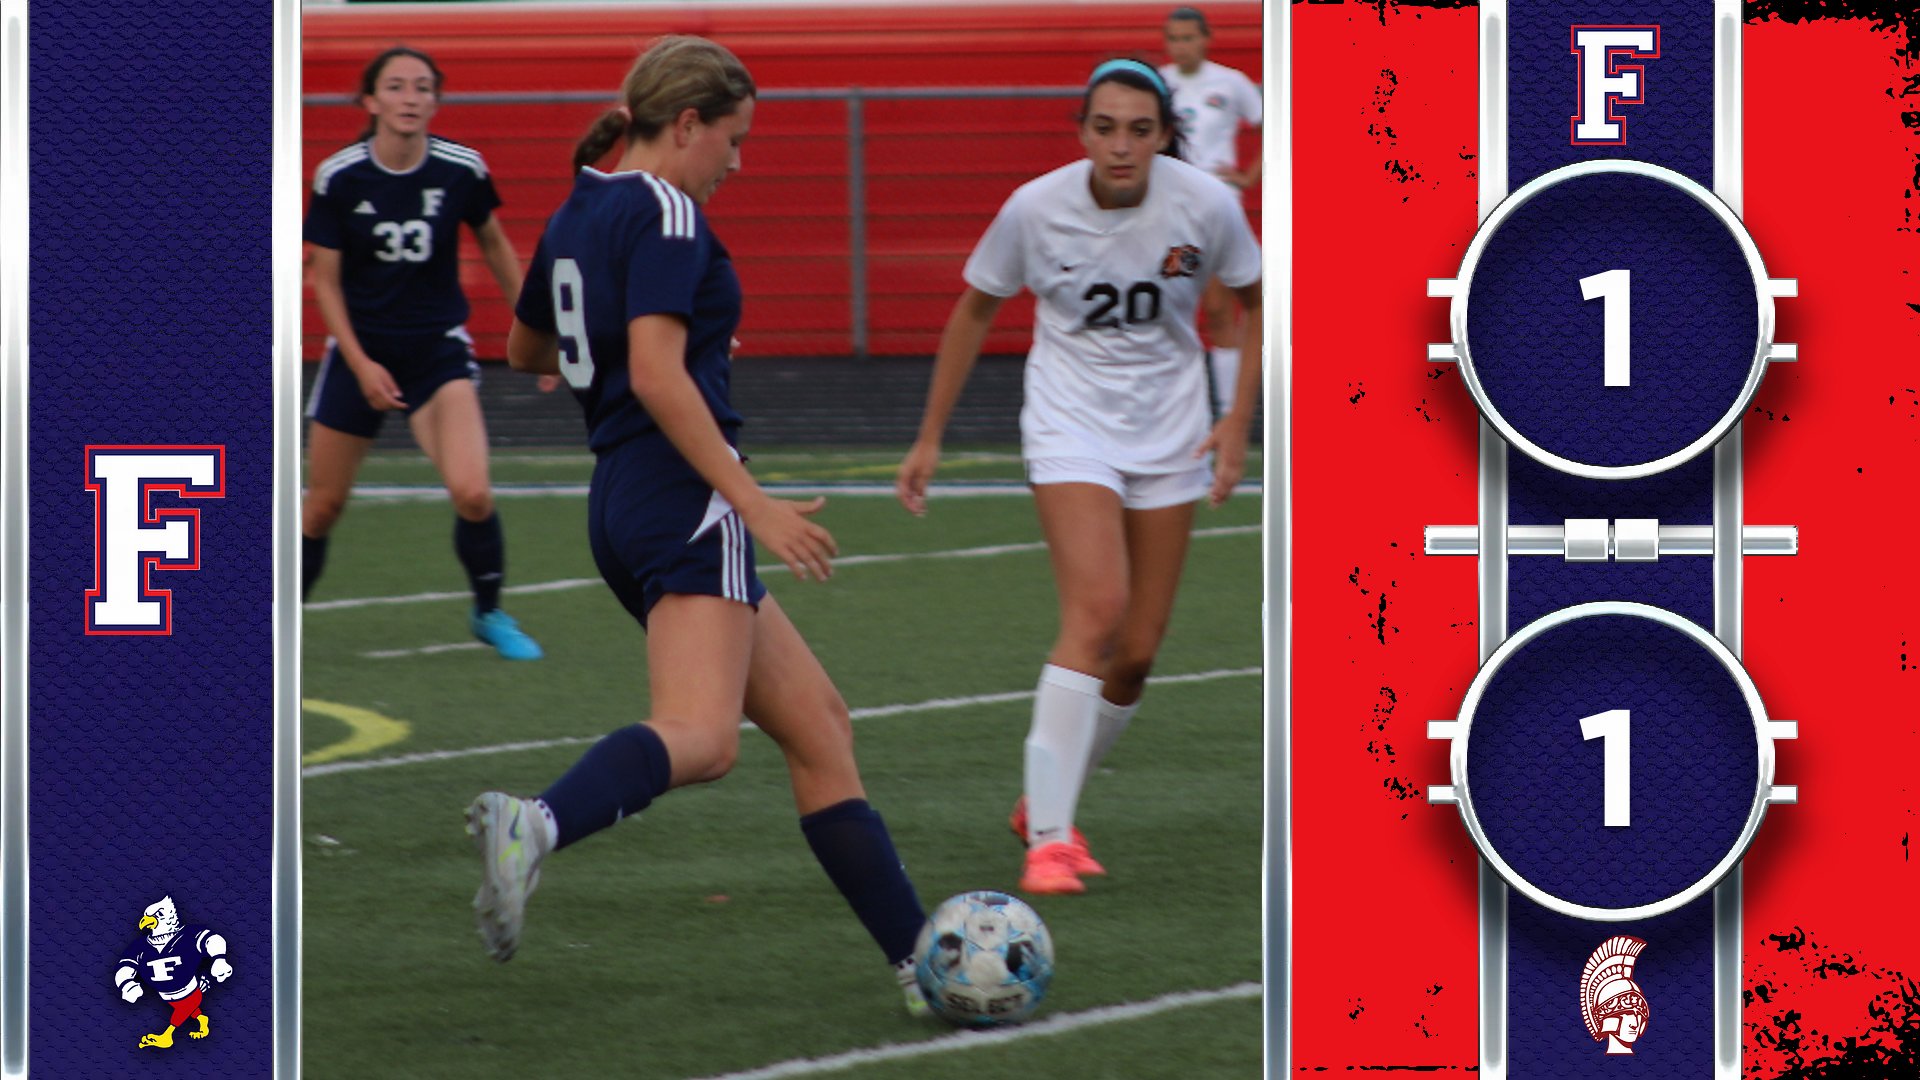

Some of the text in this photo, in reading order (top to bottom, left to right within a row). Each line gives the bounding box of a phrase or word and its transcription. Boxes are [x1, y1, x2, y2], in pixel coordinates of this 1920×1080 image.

[421, 188, 446, 217] F
[372, 219, 432, 262] 33
[552, 258, 595, 388] 9
[1083, 281, 1161, 328] 20
